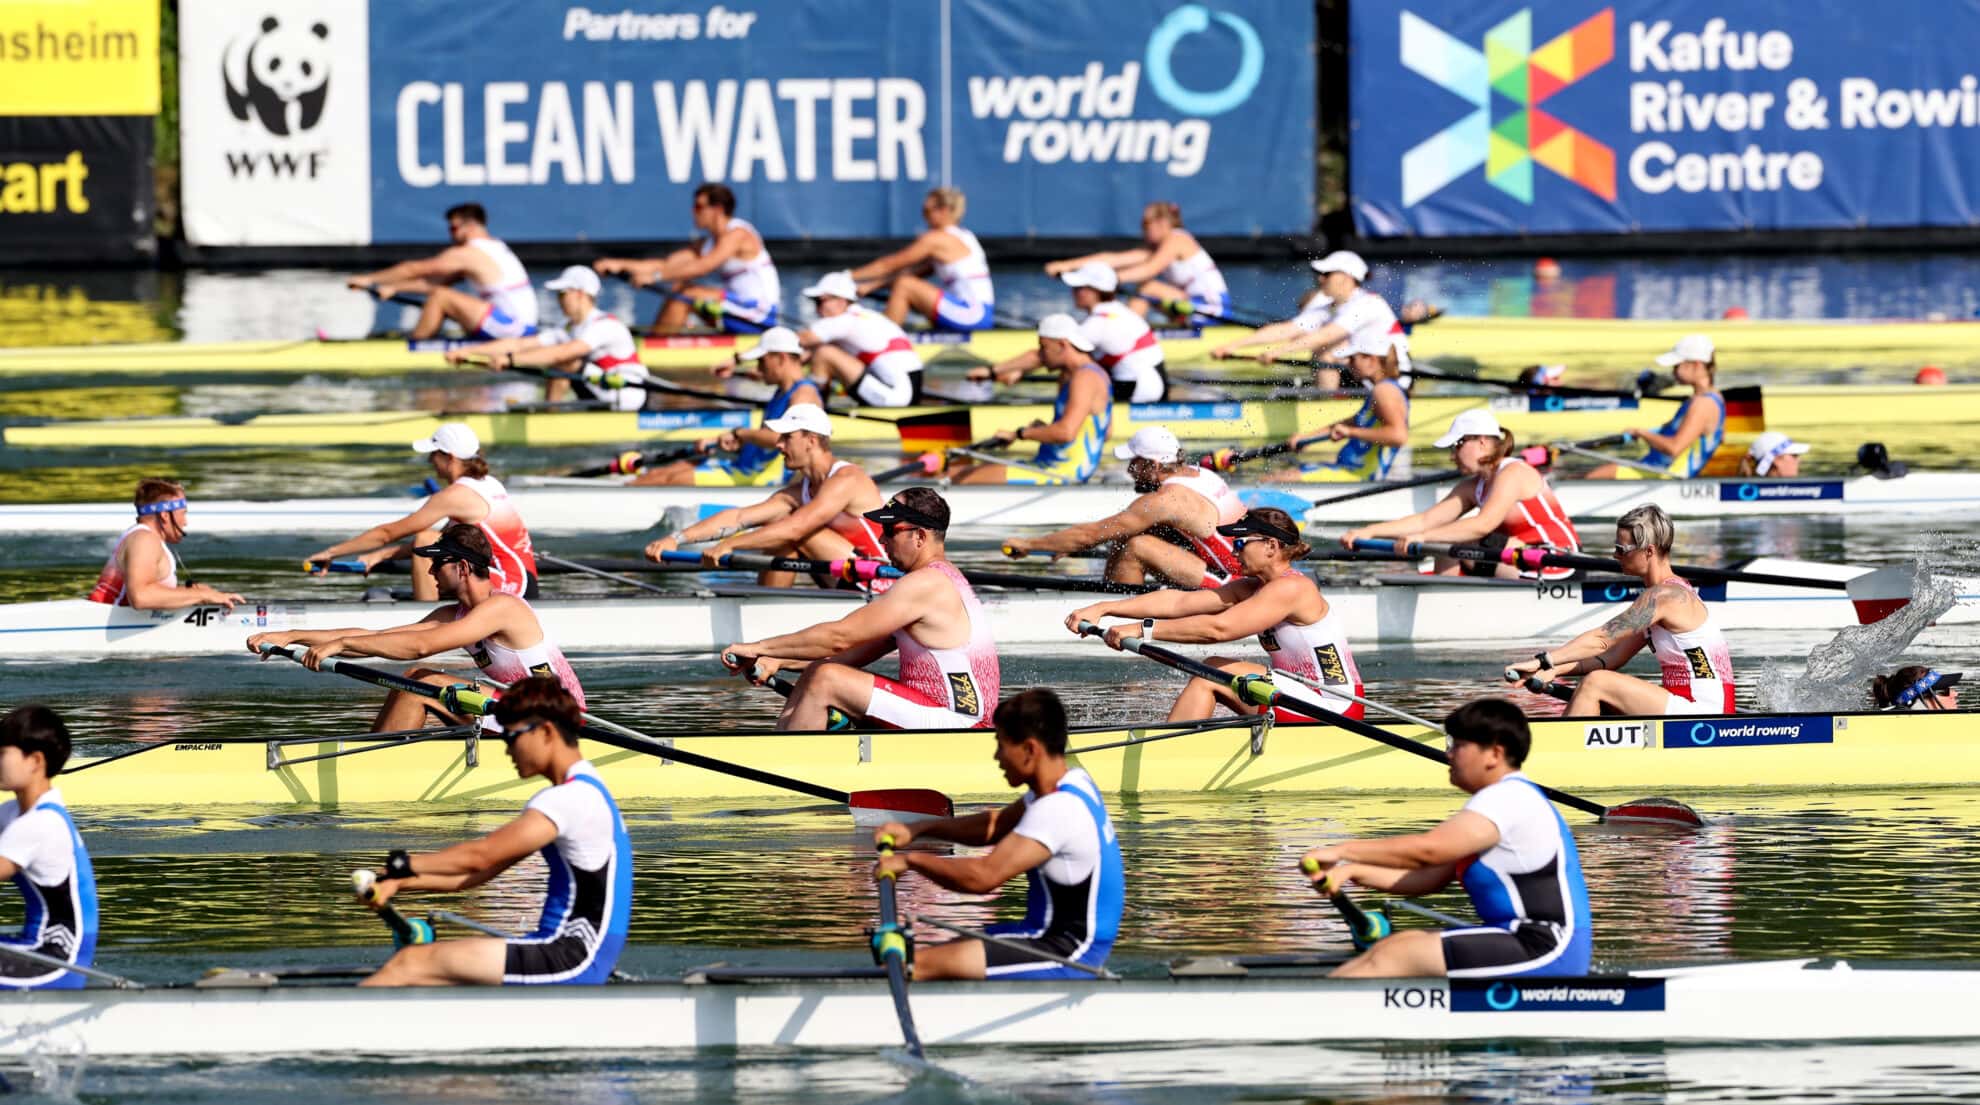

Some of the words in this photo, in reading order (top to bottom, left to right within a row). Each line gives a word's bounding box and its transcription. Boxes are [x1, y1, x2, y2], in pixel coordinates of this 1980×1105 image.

[0, 20, 139, 61] sheim
[563, 7, 700, 41] Partners
[706, 5, 758, 39] for
[1629, 19, 1793, 72] Kafue
[968, 62, 1140, 118] world
[1629, 80, 1774, 132] River
[1785, 78, 1828, 130] &
[1840, 74, 1980, 129] Rowi
[396, 81, 635, 187] CLEAN
[653, 79, 927, 182] WATER
[1003, 119, 1210, 176] rowing
[0, 150, 90, 214] art
[225, 150, 329, 179] WWF
[1629, 141, 1823, 194] Centre
[1680, 484, 1714, 498] UKR
[1537, 584, 1577, 600] POL
[1586, 726, 1641, 745] AUT
[1719, 724, 1755, 738] world
[1756, 725, 1800, 738] rowing
[1385, 988, 1446, 1008] KOR
[1522, 988, 1568, 1002] world
[1569, 989, 1625, 1005] rowing
